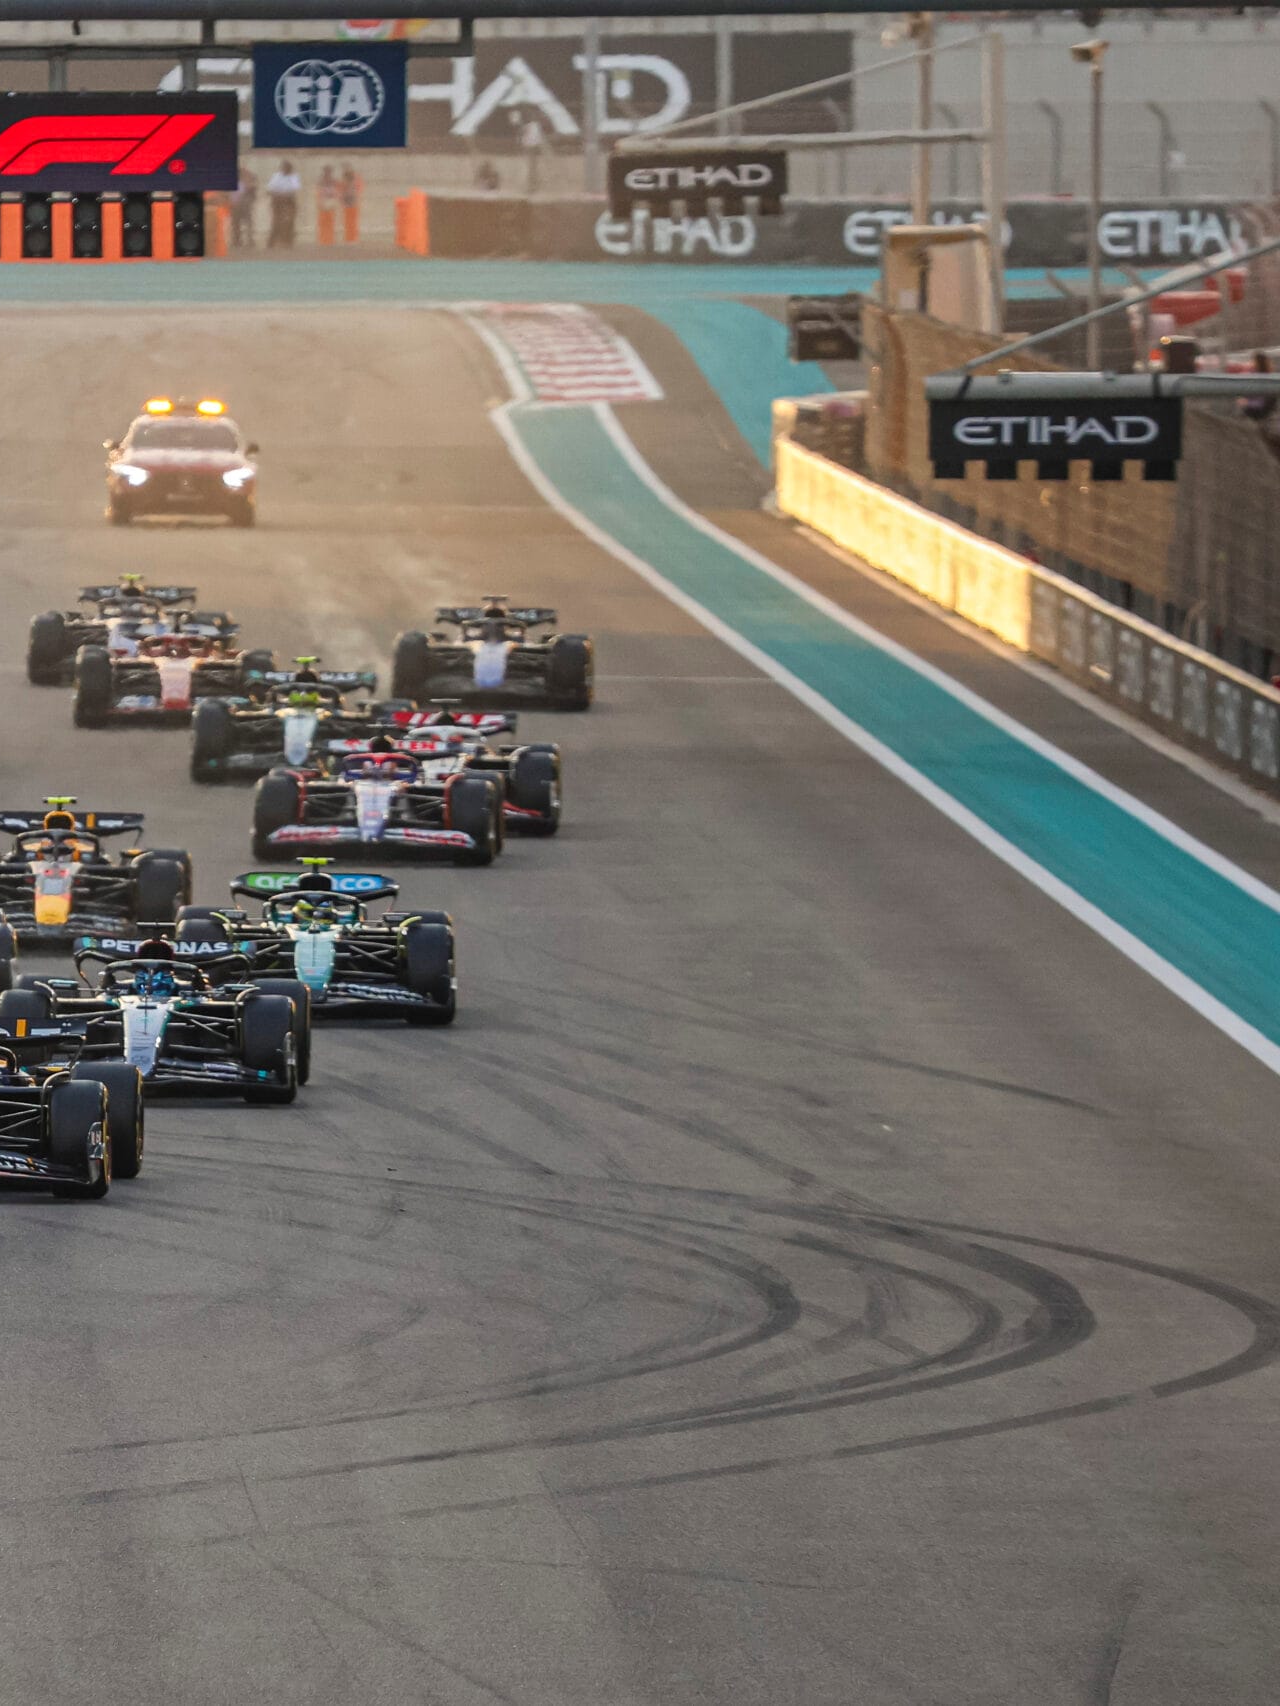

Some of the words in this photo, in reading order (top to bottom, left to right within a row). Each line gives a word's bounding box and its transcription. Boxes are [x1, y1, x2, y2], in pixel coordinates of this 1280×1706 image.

[624, 163, 773, 190] ETIHAD
[953, 416, 1158, 444] ETIHAD
[255, 875, 376, 891] arco
[101, 939, 228, 953] PETNAS
